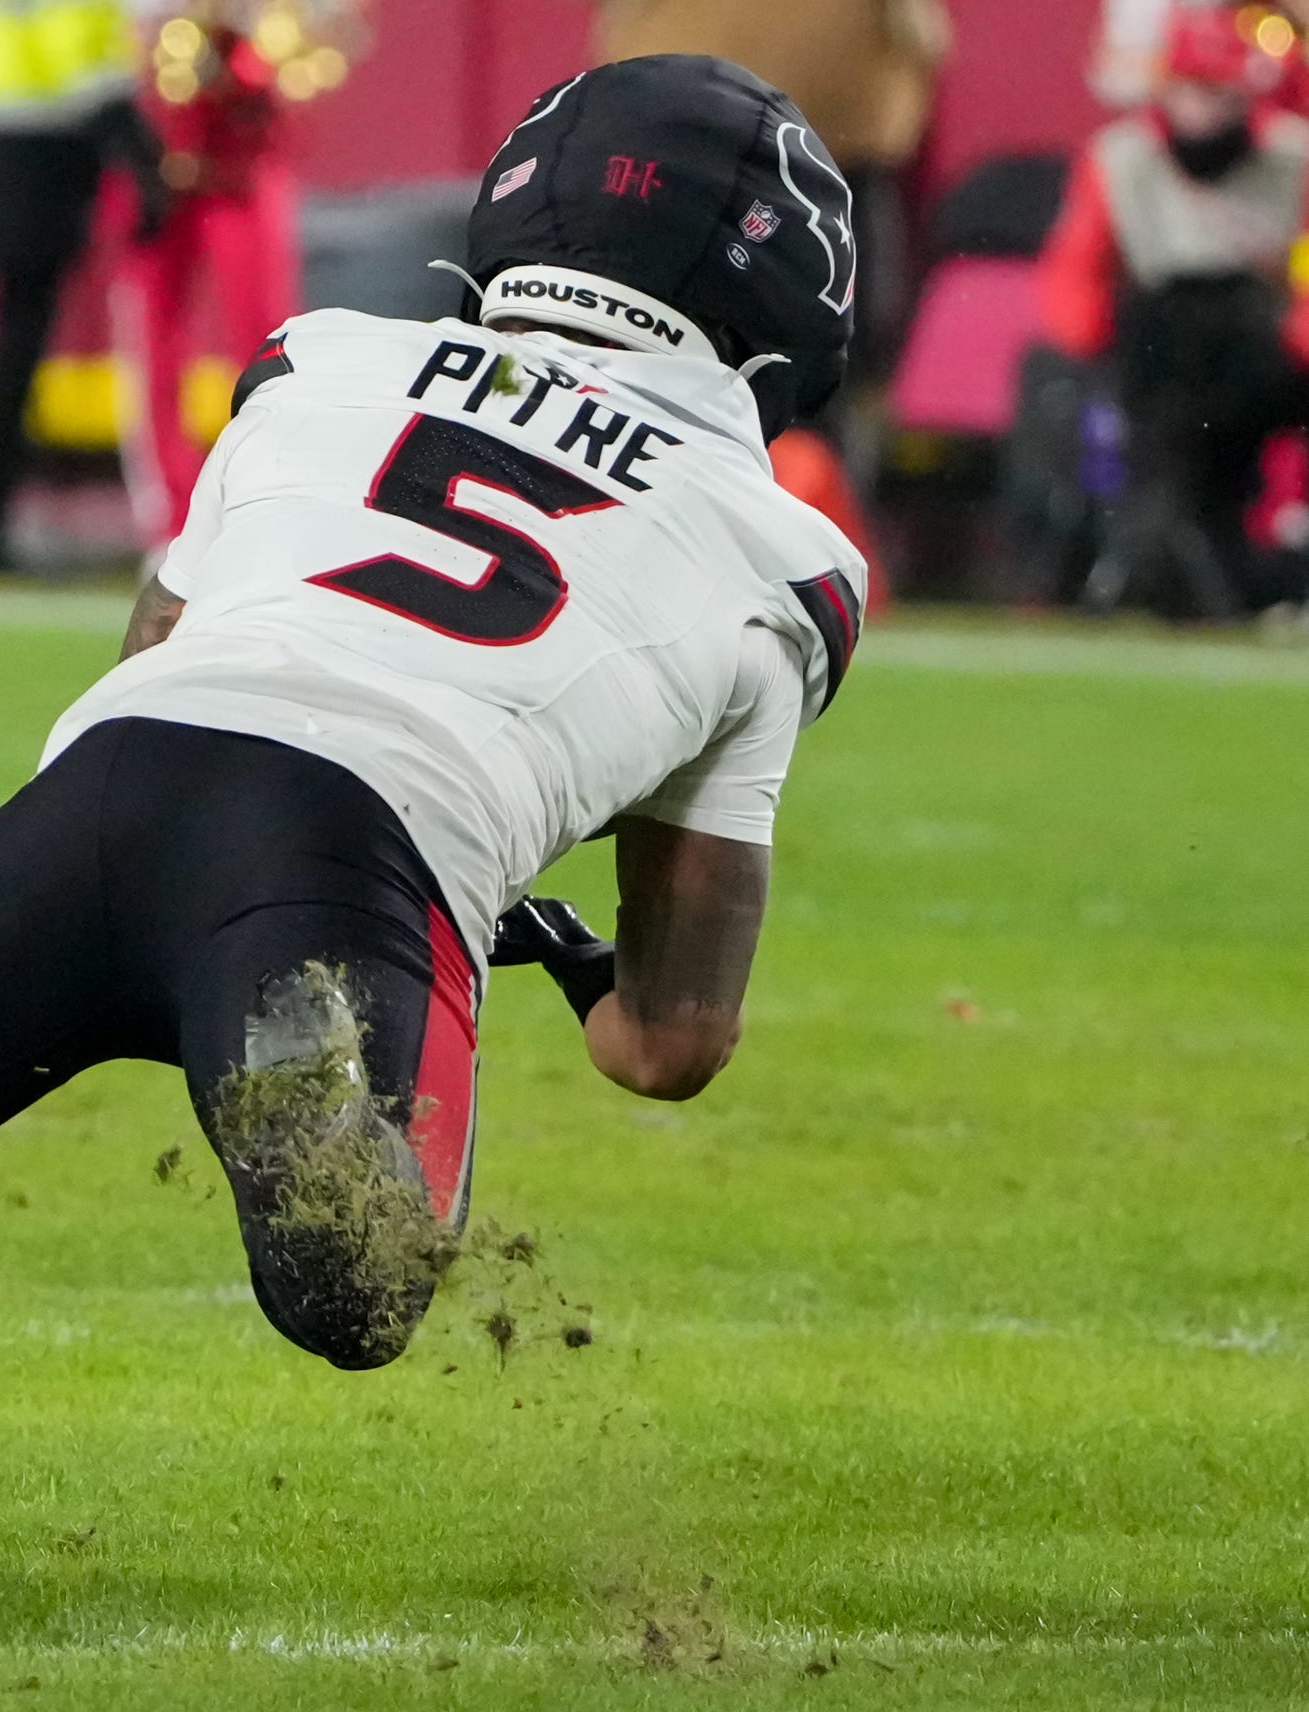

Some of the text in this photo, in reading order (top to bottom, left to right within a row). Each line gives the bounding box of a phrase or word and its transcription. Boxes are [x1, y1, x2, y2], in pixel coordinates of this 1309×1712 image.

[744, 213, 769, 239] NFL
[501, 280, 685, 347] HOUSTON
[406, 340, 684, 492] PITRE
[302, 411, 626, 647] 5
